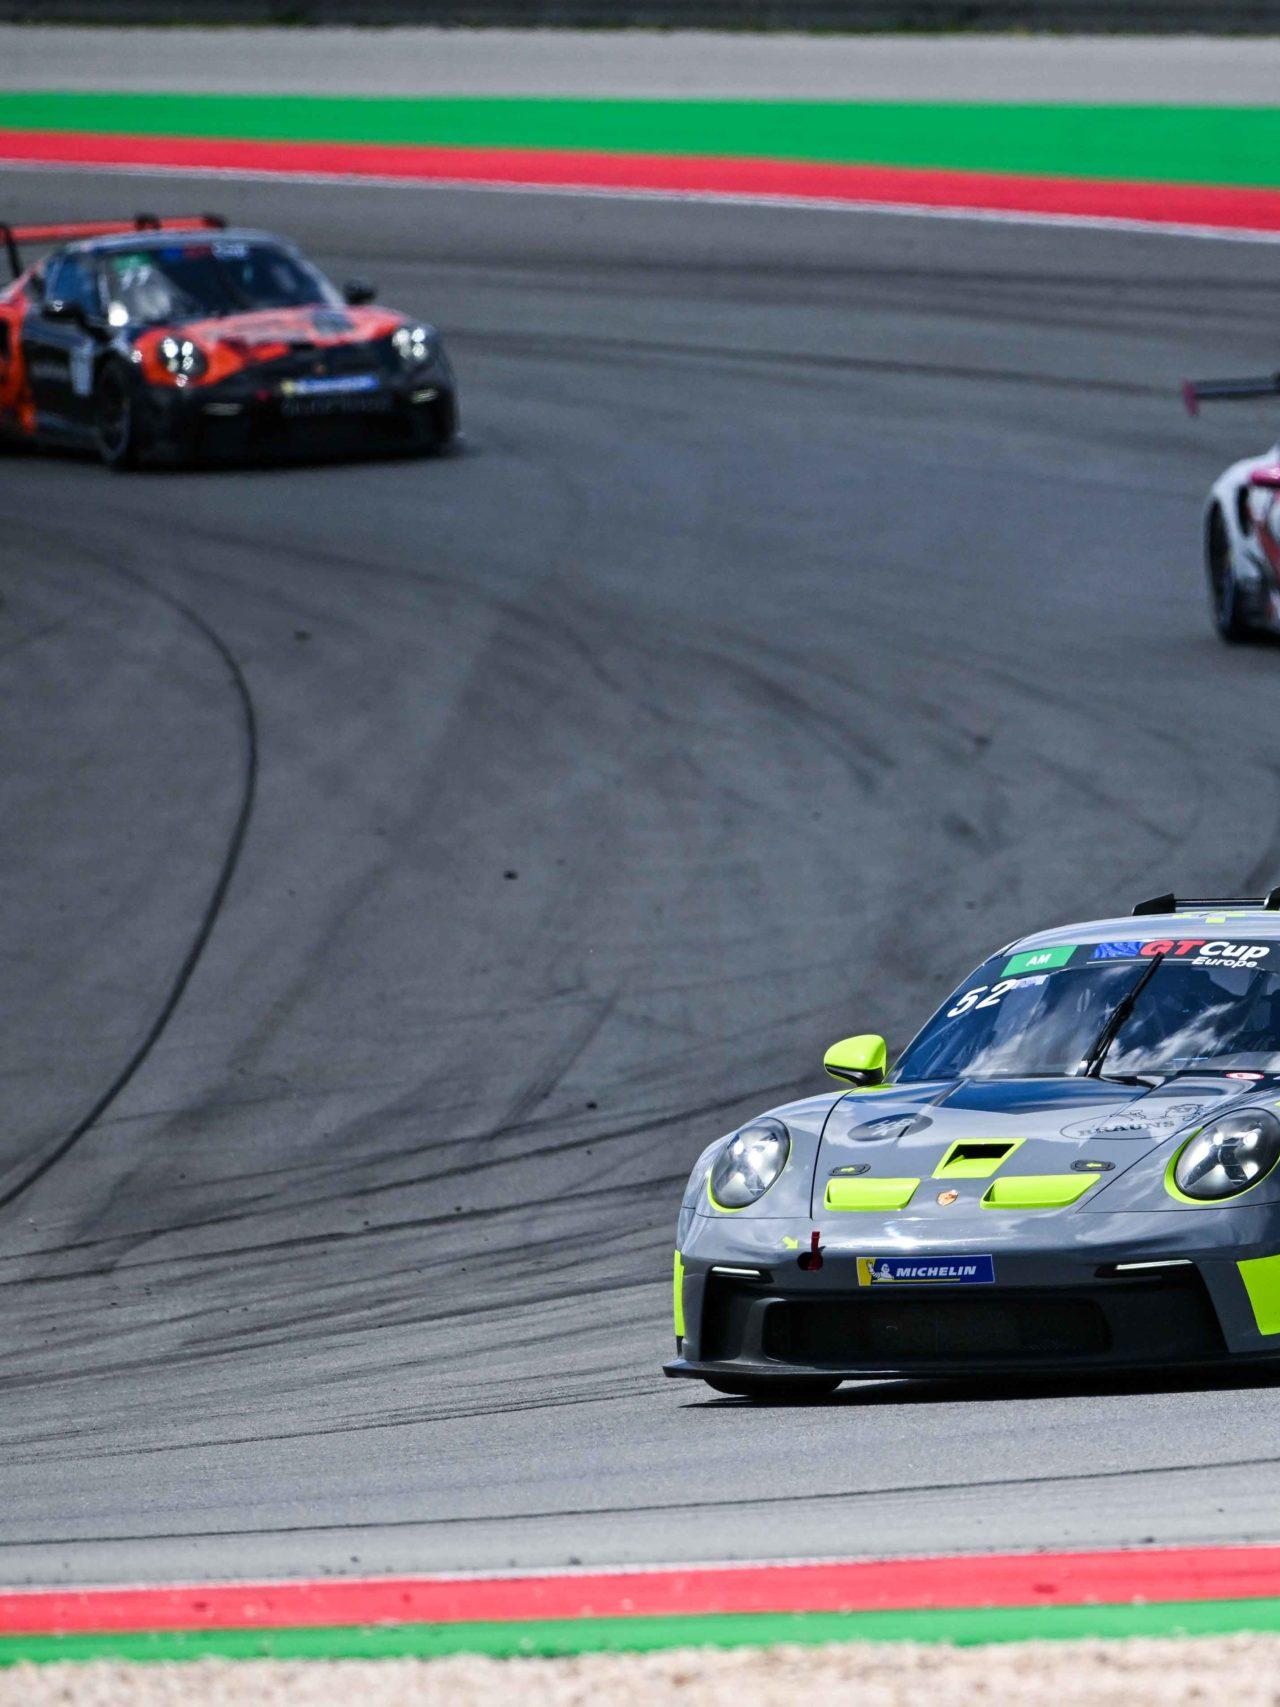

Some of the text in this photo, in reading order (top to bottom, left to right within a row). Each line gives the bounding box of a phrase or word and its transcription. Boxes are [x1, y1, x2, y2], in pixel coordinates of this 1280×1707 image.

[1025, 953, 1052, 967] AM
[1191, 956, 1258, 969] Europe
[947, 979, 1017, 1018] 52
[895, 1265, 977, 1277] MICHELIN
